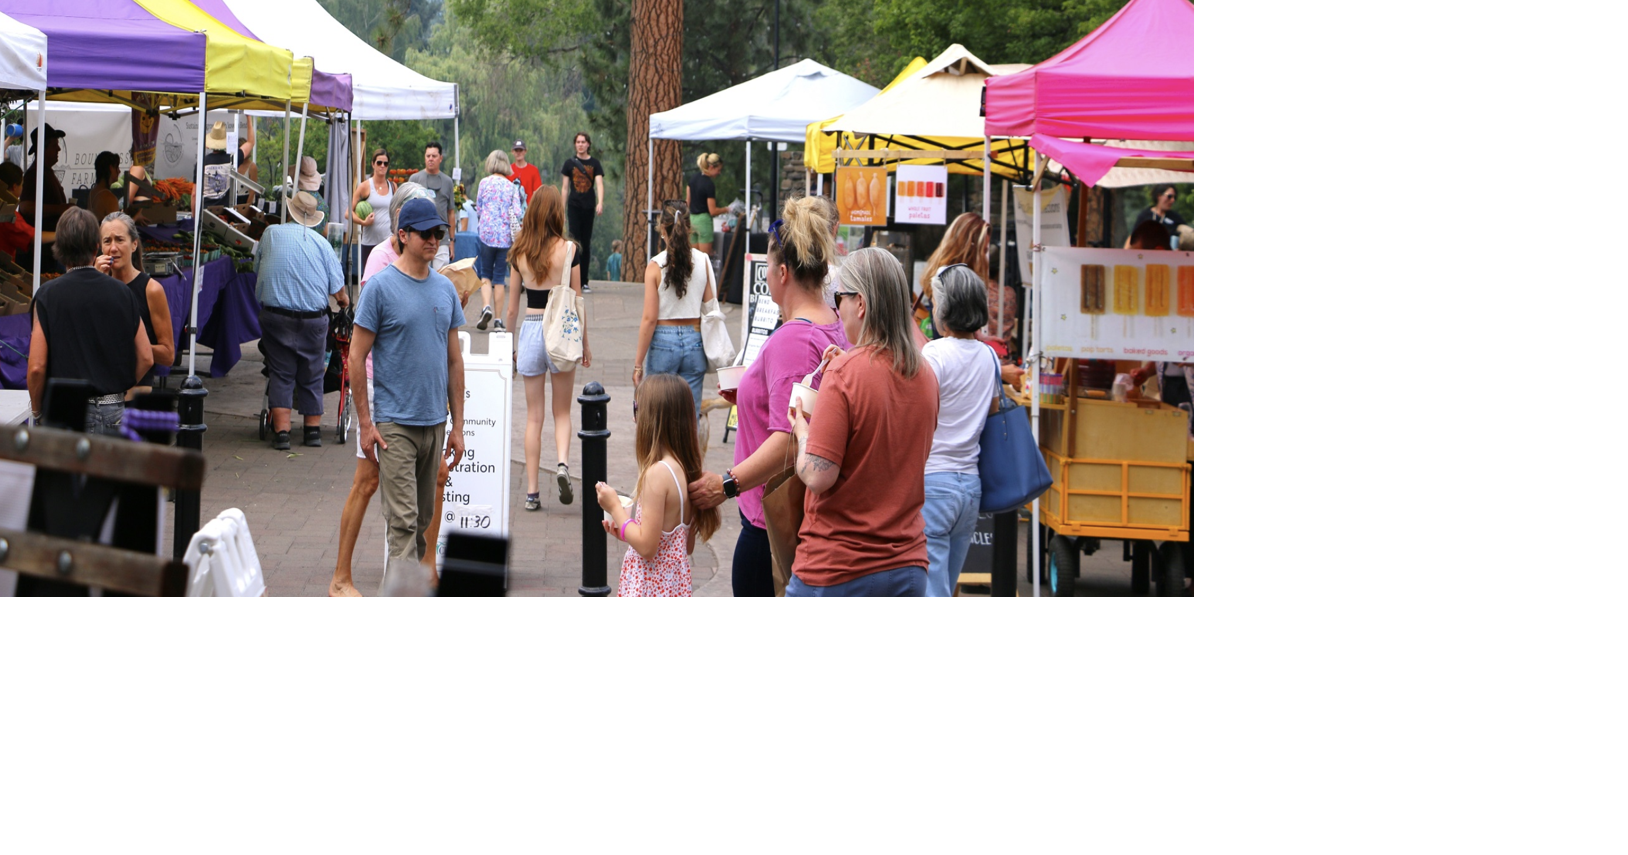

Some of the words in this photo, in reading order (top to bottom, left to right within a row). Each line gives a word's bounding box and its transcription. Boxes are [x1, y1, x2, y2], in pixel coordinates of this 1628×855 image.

[1147, 349, 1168, 357] goods
[442, 490, 470, 505] sting
[444, 511, 455, 523] @
[460, 515, 491, 529] 11:30
